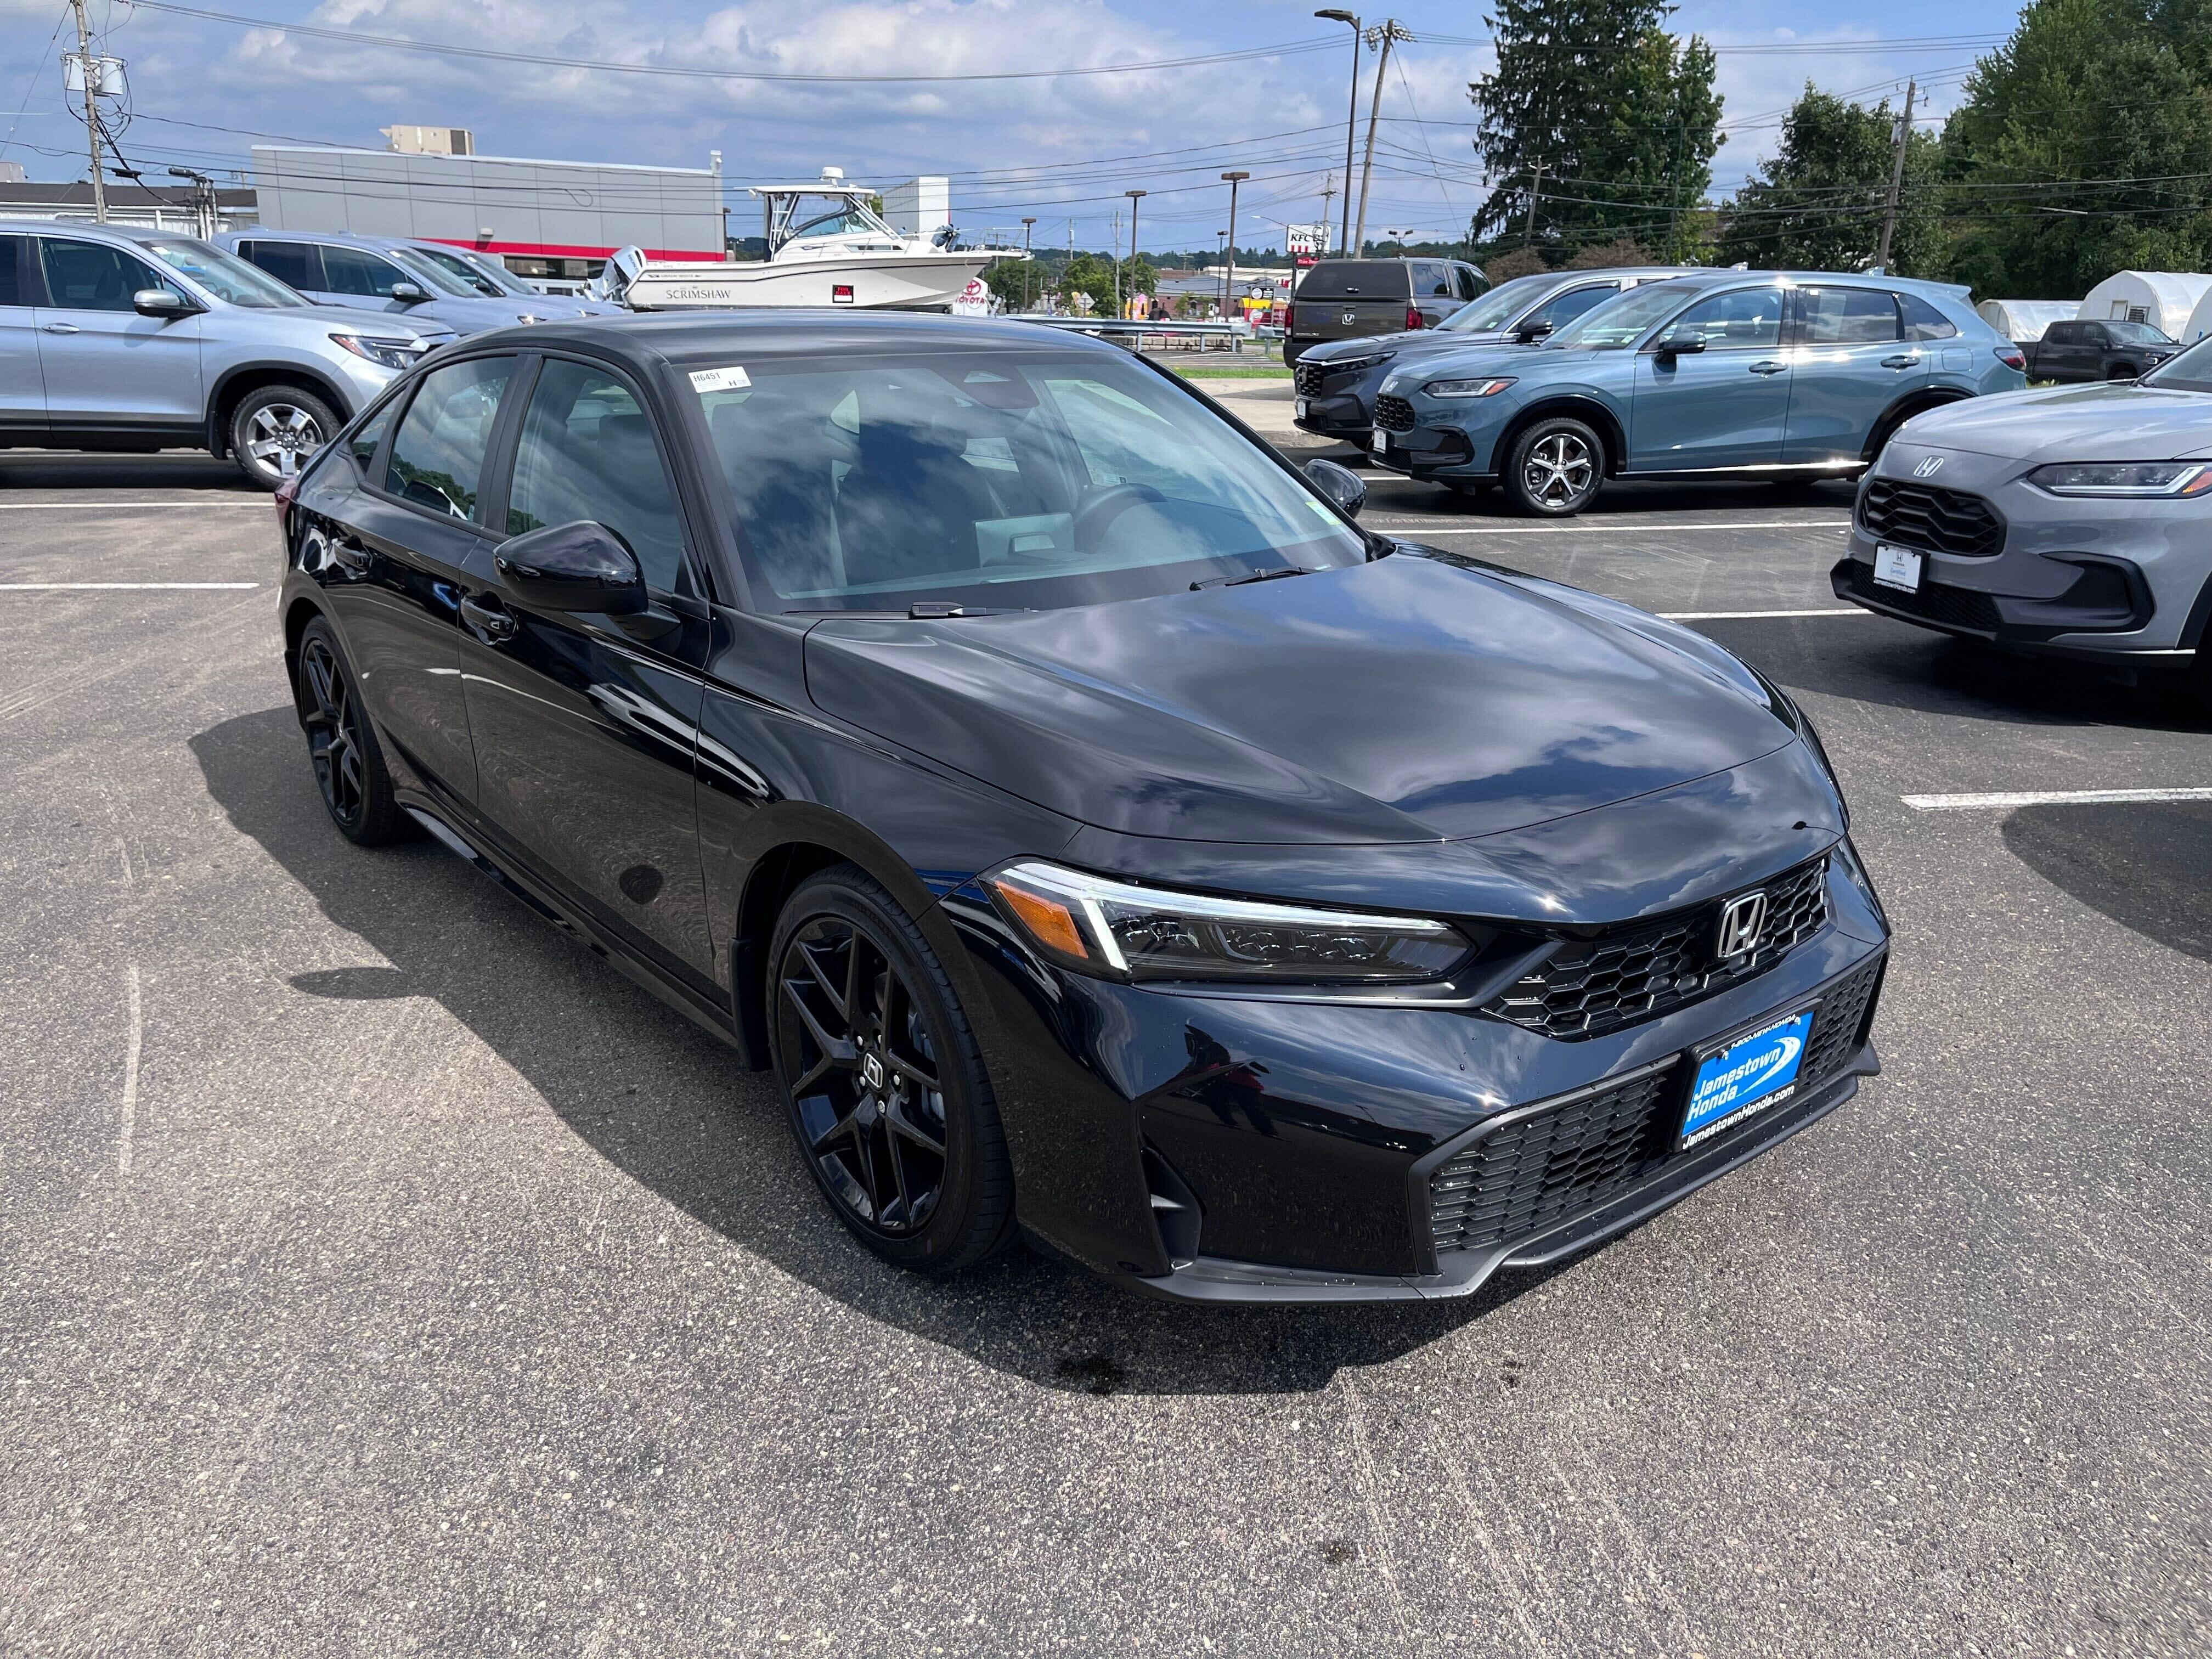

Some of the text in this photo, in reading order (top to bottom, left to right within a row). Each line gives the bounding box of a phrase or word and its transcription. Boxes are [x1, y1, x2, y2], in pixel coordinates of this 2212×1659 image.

[1290, 234, 1310, 242] KFC
[666, 290, 731, 299] SCRIMSHAW
[693, 373, 720, 382] H6451
[1694, 1046, 1781, 1102] Jamestown
[1686, 1084, 1739, 1122] Honda
[1682, 1085, 1795, 1150] JamestownHonda.com
